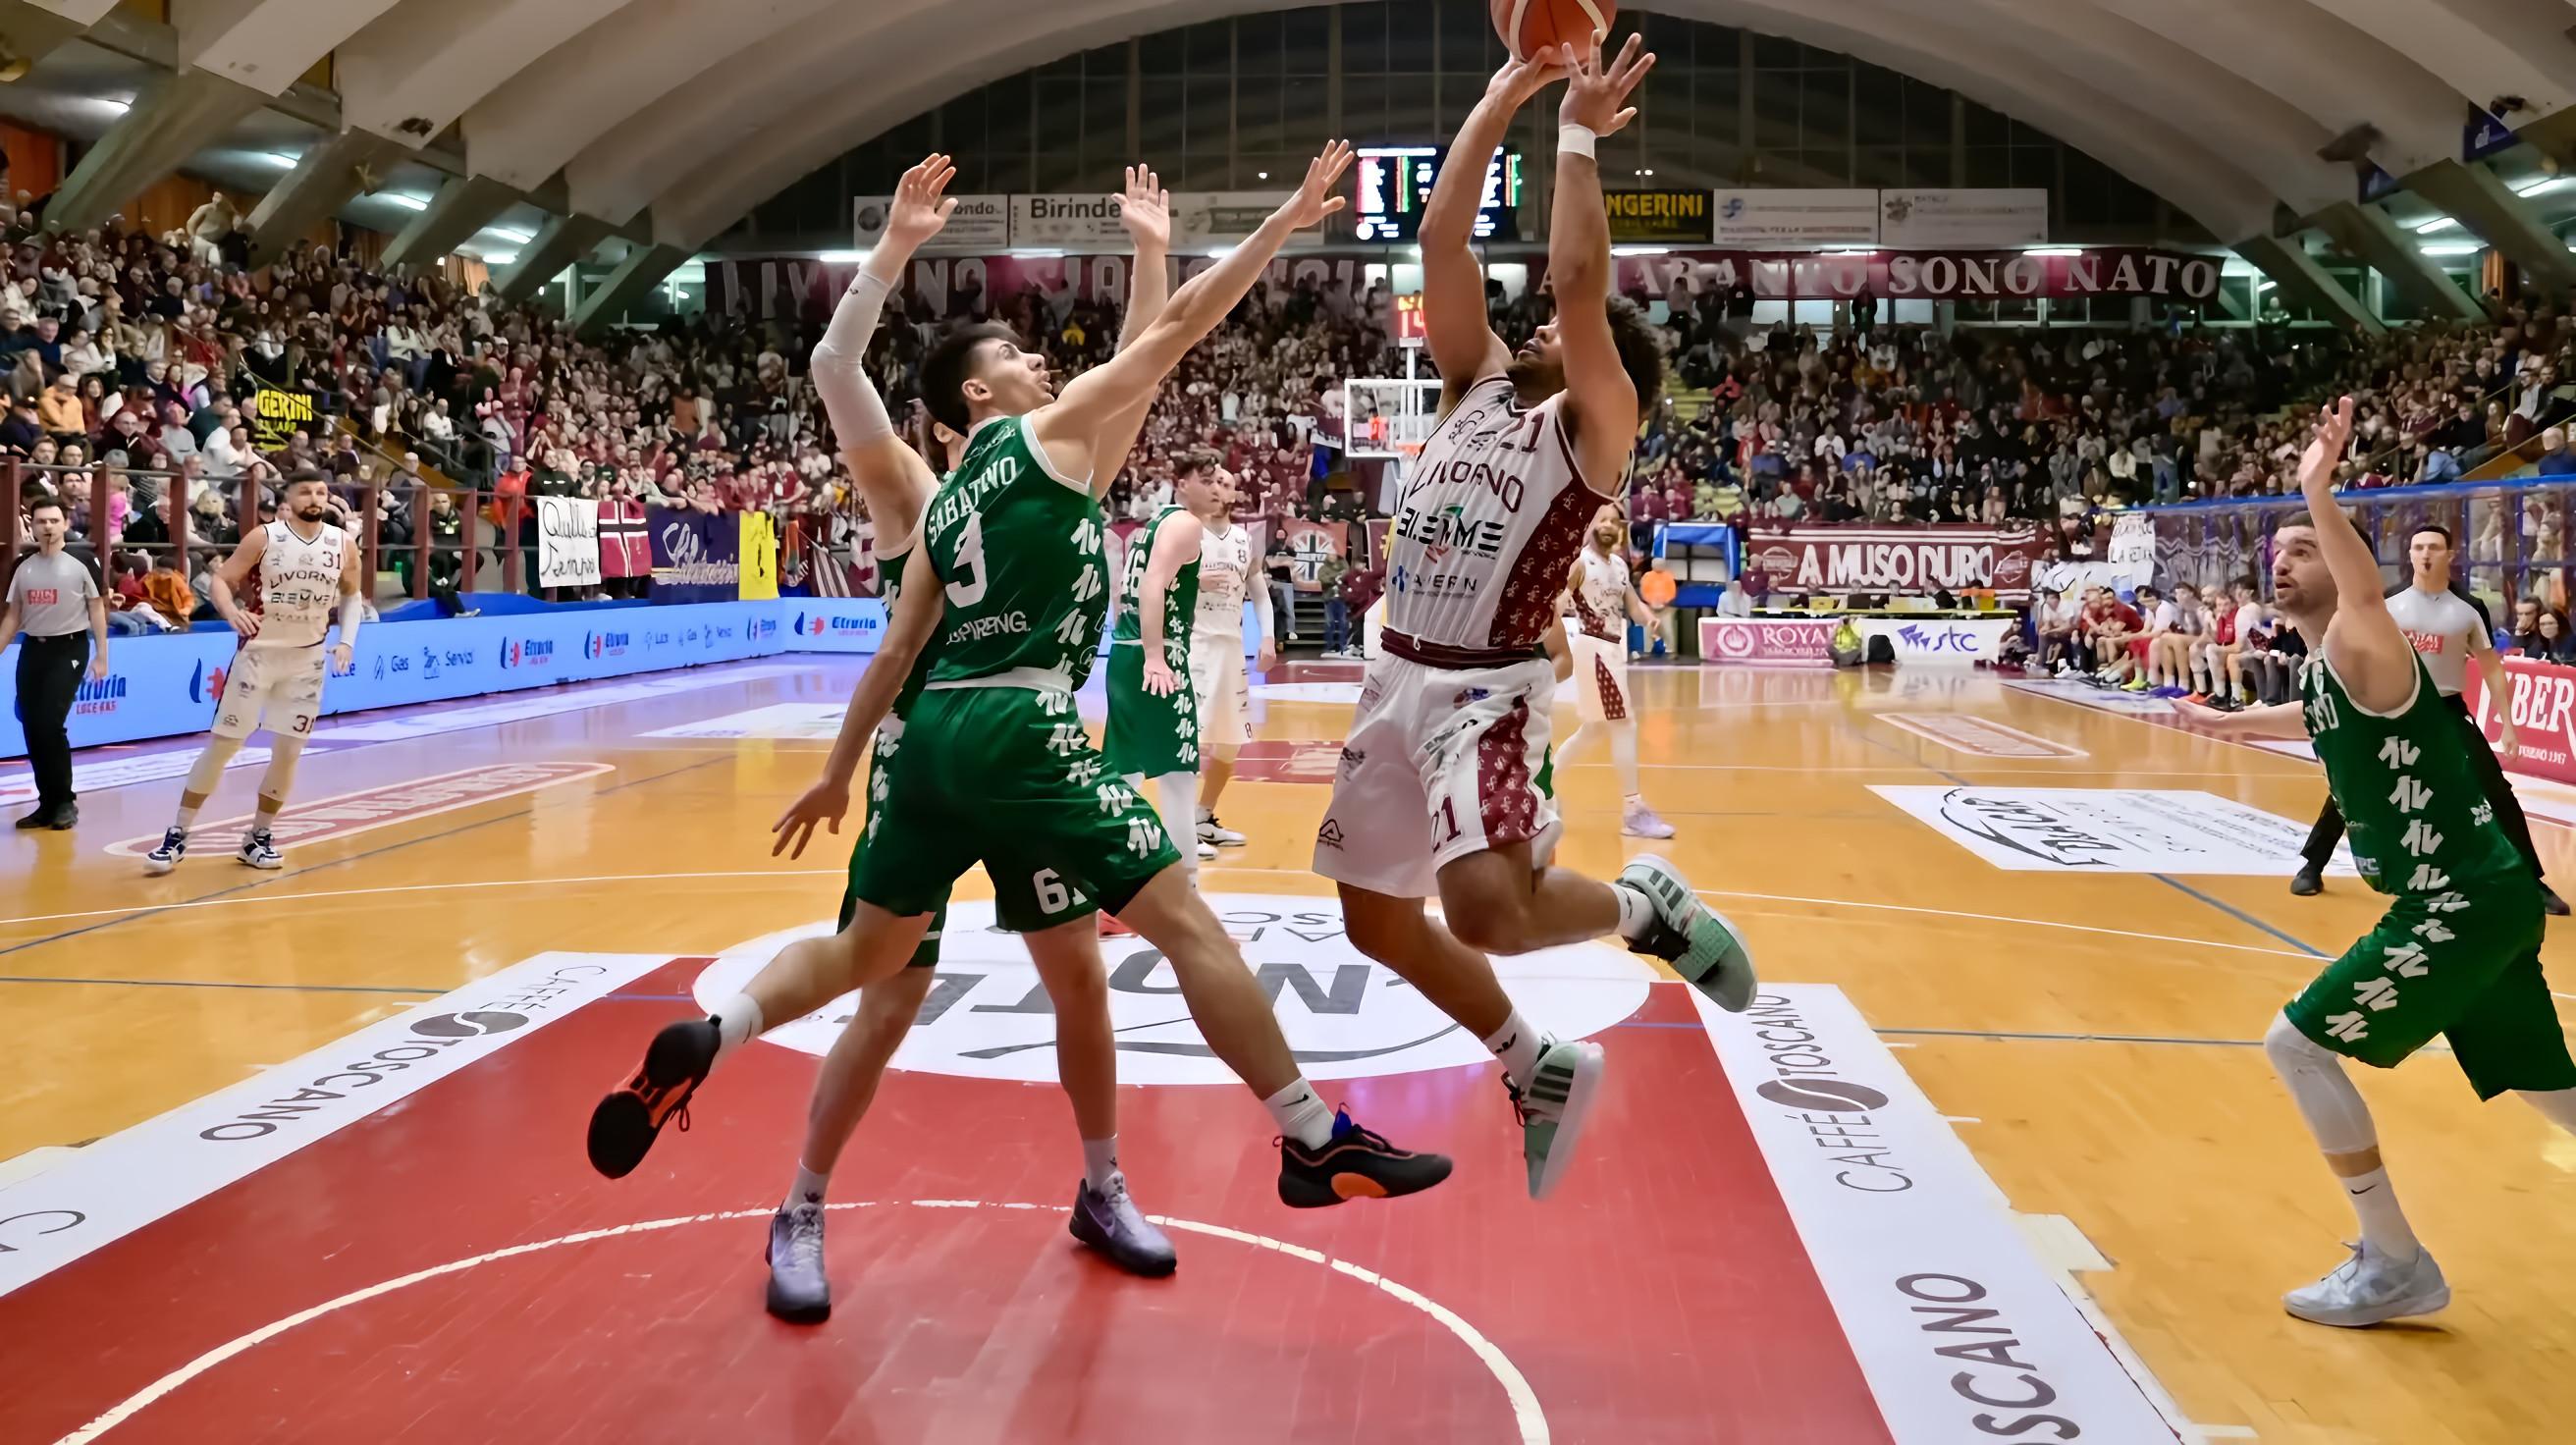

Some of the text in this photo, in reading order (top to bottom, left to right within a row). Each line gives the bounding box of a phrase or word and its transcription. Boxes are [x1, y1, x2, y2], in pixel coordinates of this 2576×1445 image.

[1031, 197, 1122, 219] Birinde
[1605, 193, 1703, 217] NGERINI
[723, 258, 988, 320] LIVONO
[1537, 253, 2218, 299] AARANTO SONO NATO
[322, 550, 341, 569] 31
[944, 510, 988, 609] 3
[1798, 544, 1824, 586] A
[1827, 544, 1915, 587] MUSO
[1932, 625, 1979, 653] stc
[392, 655, 409, 671] Gas
[74, 673, 127, 702] truria
[1033, 867, 1088, 915] 6
[199, 1038, 463, 1142] TOSCANO
[1895, 1272, 2081, 1445] SCANO
